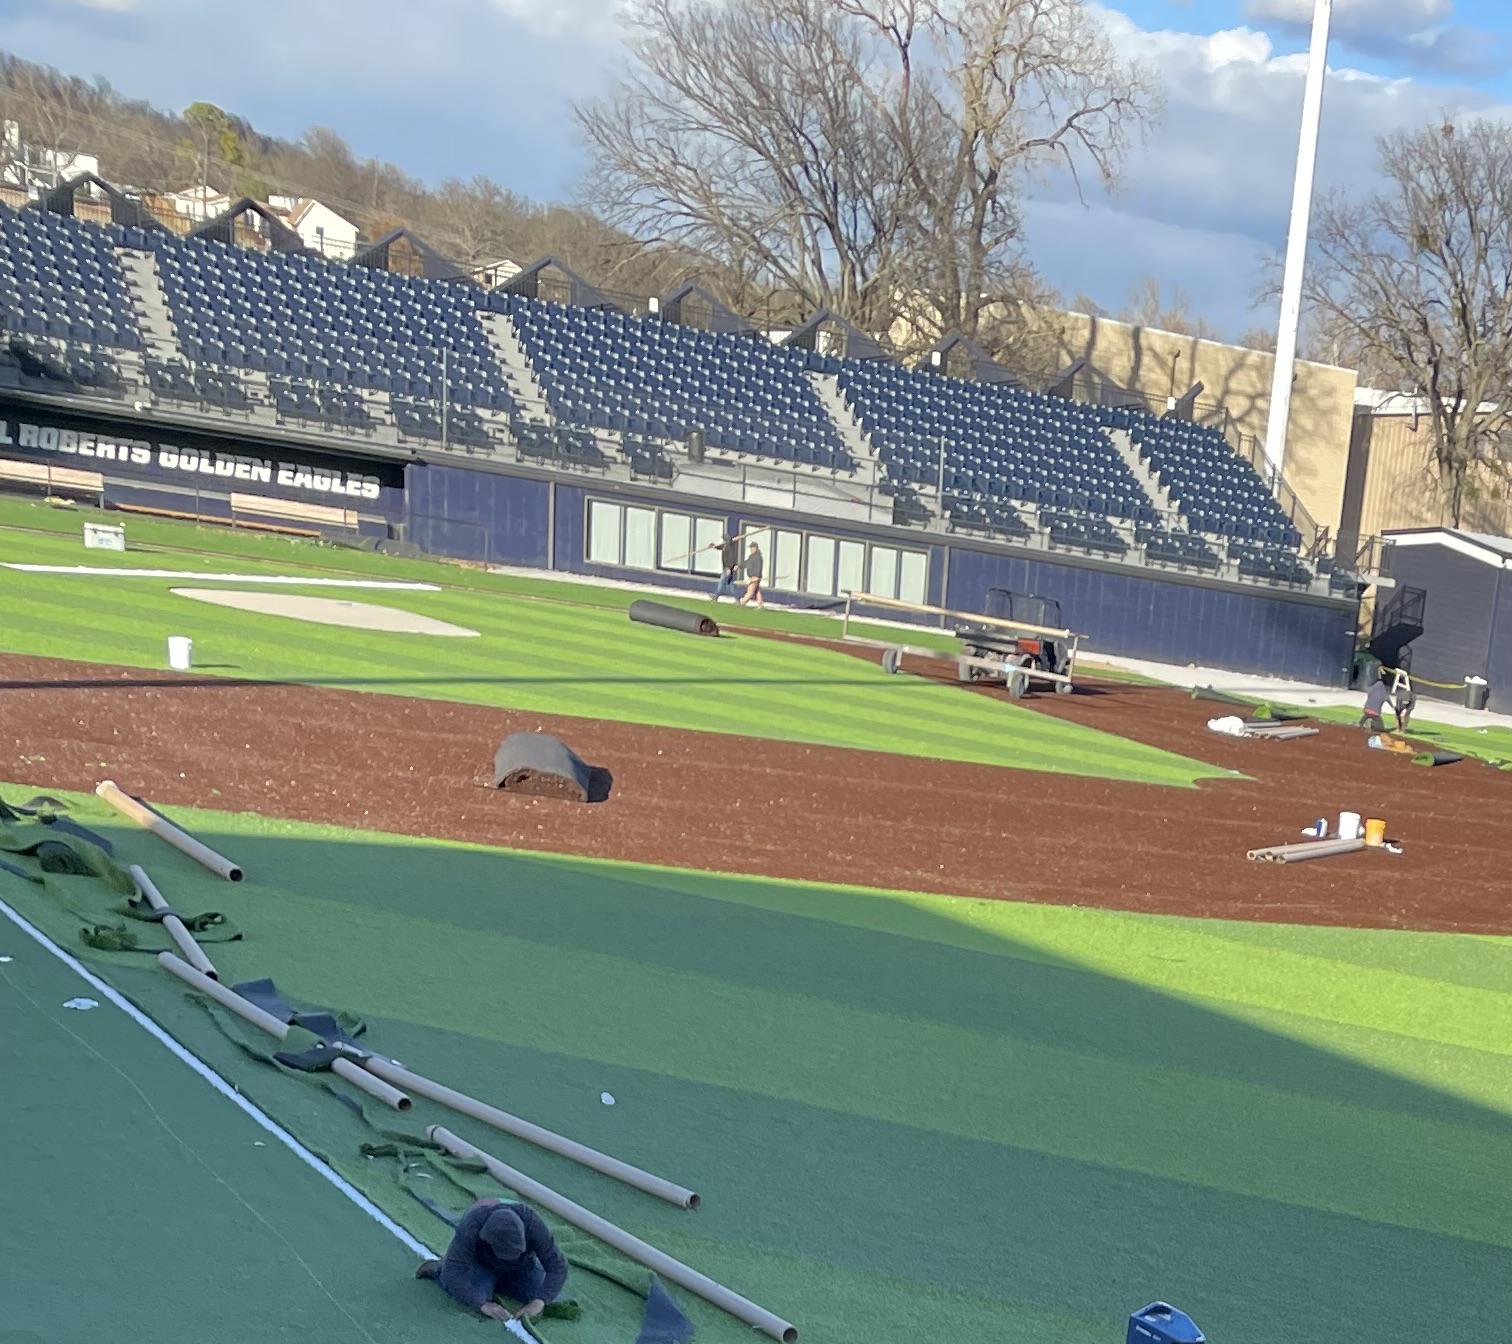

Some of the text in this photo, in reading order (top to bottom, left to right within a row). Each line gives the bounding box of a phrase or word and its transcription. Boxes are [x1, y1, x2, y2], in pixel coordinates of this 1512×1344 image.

[19, 423, 151, 464] ROBERTS
[158, 442, 272, 483] GOLDEN
[277, 461, 381, 499] EAGLES
